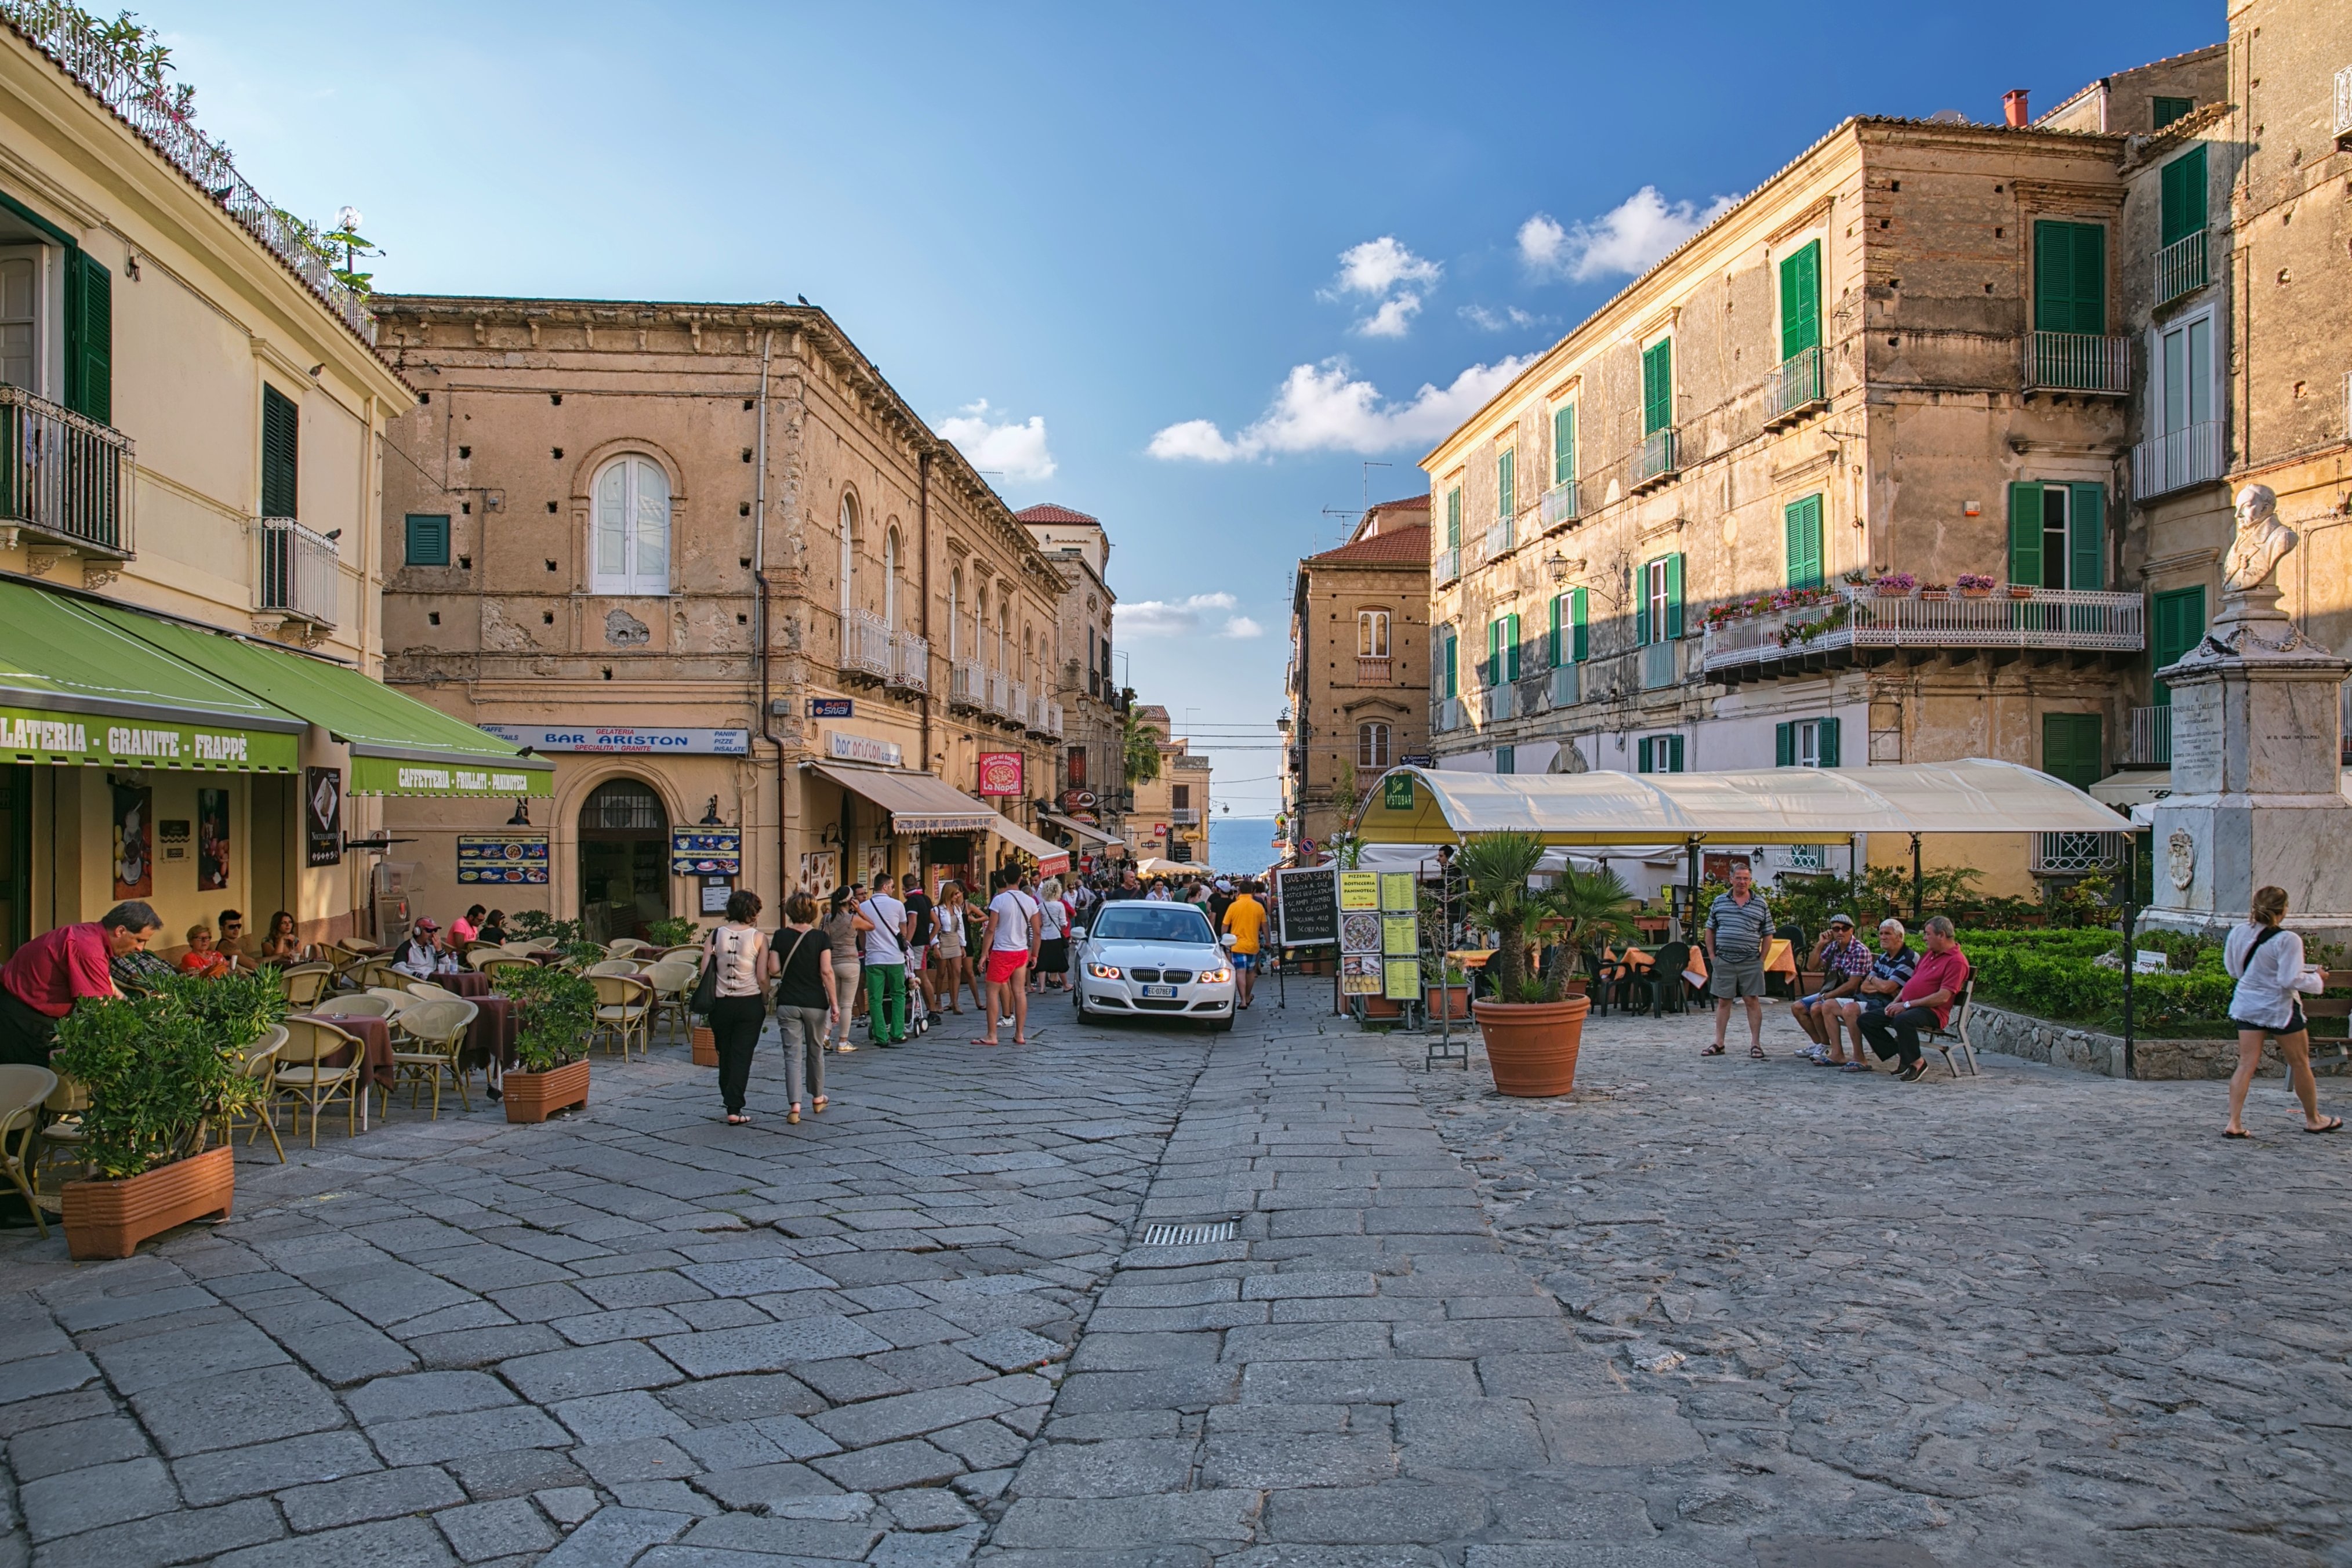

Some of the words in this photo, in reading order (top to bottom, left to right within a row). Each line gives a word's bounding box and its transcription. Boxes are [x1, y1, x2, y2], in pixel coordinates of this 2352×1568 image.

[2173, 705, 2195, 713] PASQUALE
[108, 727, 179, 757] GRANITE
[195, 733, 248, 761] FRAPPÈ
[545, 734, 585, 743] BAR
[598, 735, 688, 746] ARISTON
[983, 756, 997, 765] pizza
[1004, 754, 1020, 765] taglio
[399, 767, 450, 789] CAFFETTERIA
[456, 771, 487, 790] FRULLATI
[492, 774, 528, 790] PANINOTECA
[983, 781, 993, 790] La
[994, 781, 1019, 792] Napoli
[1387, 793, 1412, 805] RISTOBAR
[1156, 825, 1166, 835] illy
[1284, 873, 1312, 883] QUESTA
[1314, 872, 1333, 880] SERA
[1288, 899, 1308, 907] SCAMPI
[1311, 896, 1331, 904] JUMBO
[1306, 904, 1329, 912] GRIGLIA
